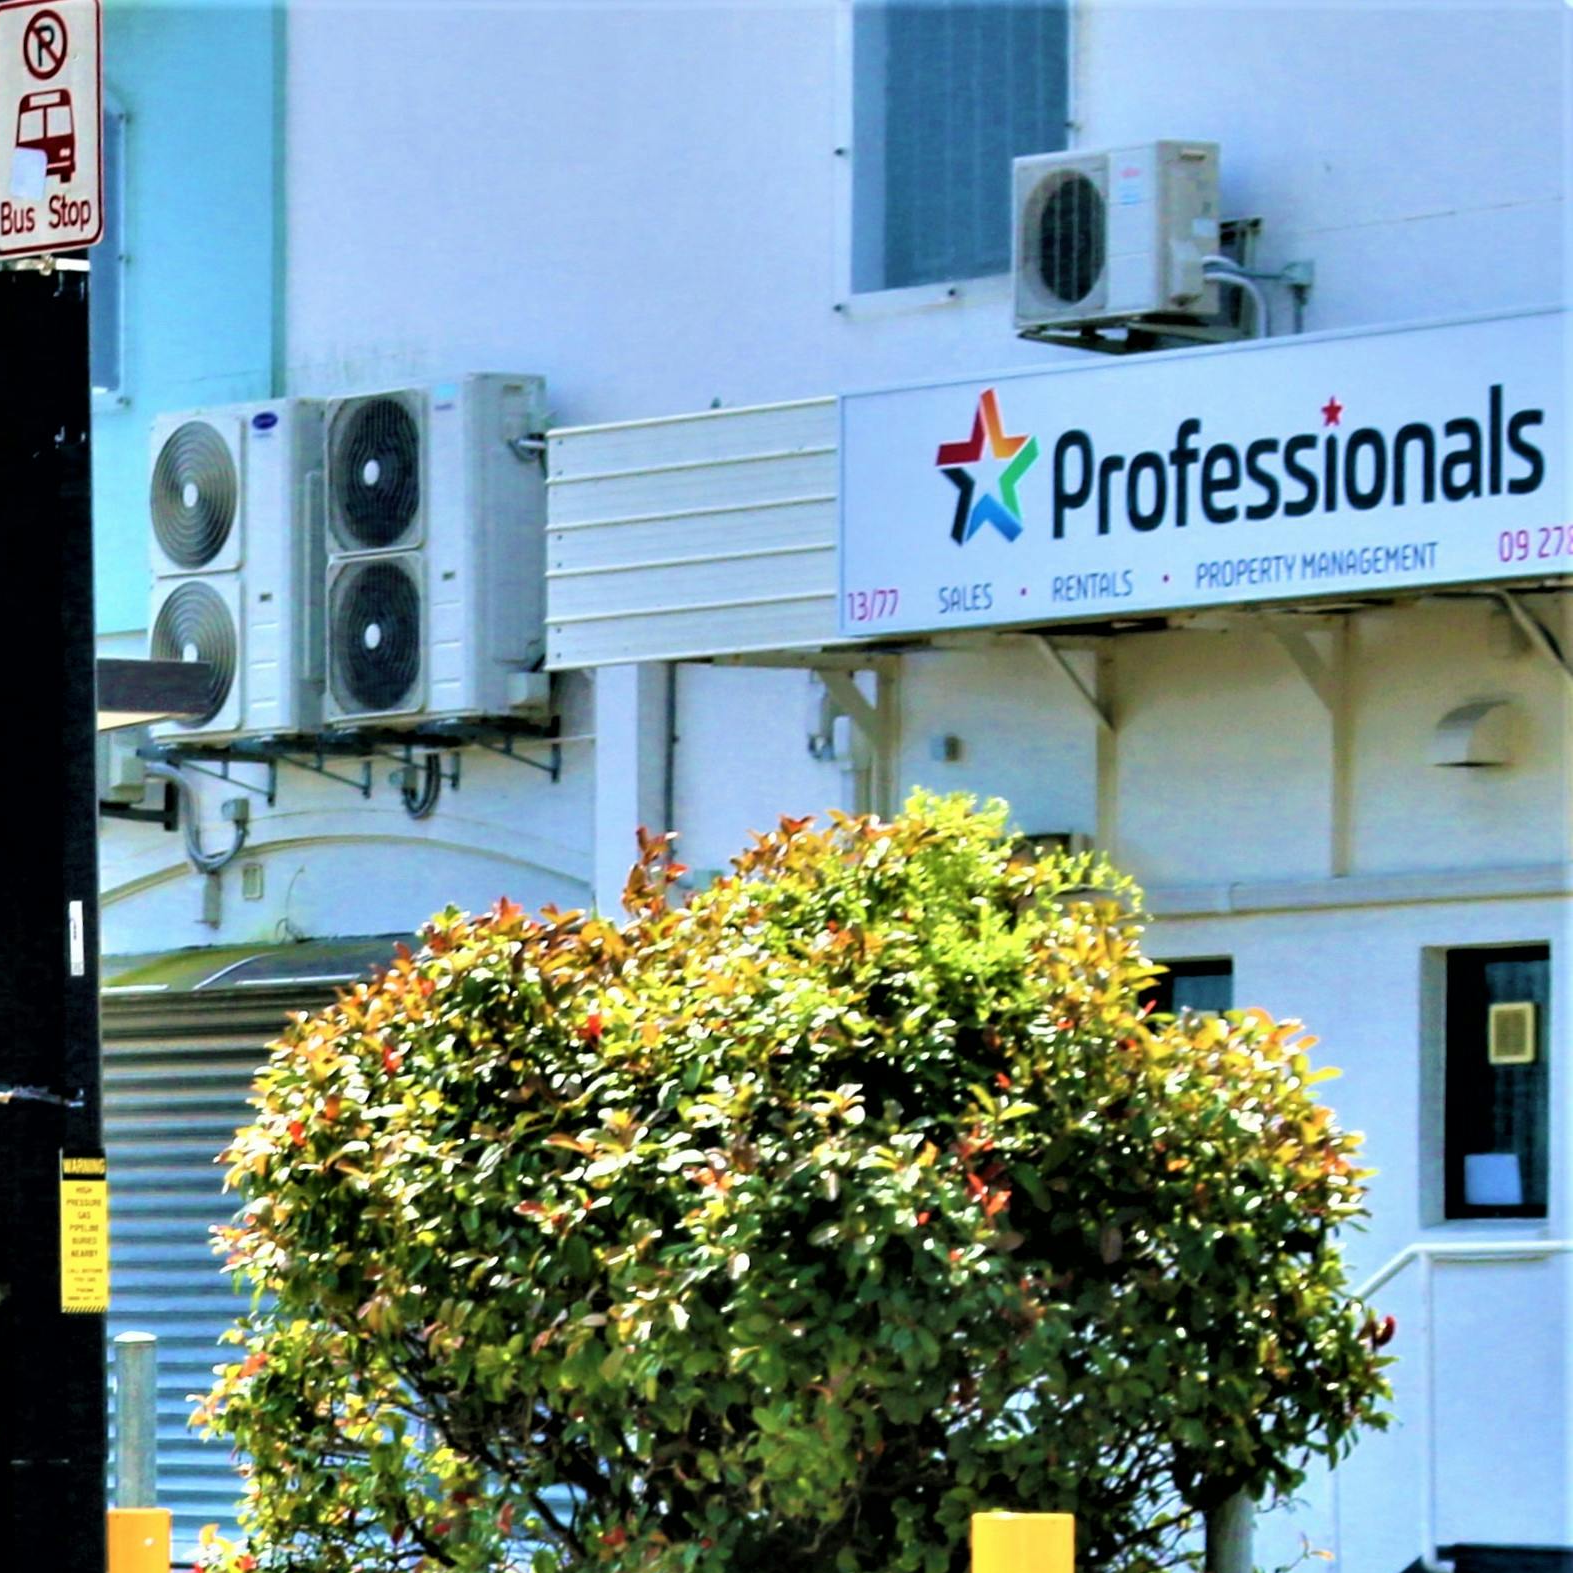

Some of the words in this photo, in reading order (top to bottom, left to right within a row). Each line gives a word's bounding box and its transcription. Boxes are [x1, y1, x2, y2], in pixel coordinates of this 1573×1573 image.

[0, 202, 35, 235] Bus
[48, 194, 91, 232] Stop
[1054, 384, 1546, 541] Professionals
[1499, 529, 1530, 562] 09
[938, 582, 993, 614] SALES
[1052, 569, 1134, 602] RENTALS
[1195, 554, 1298, 589] PROPERTY
[1301, 541, 1439, 580] MANAGEMENT
